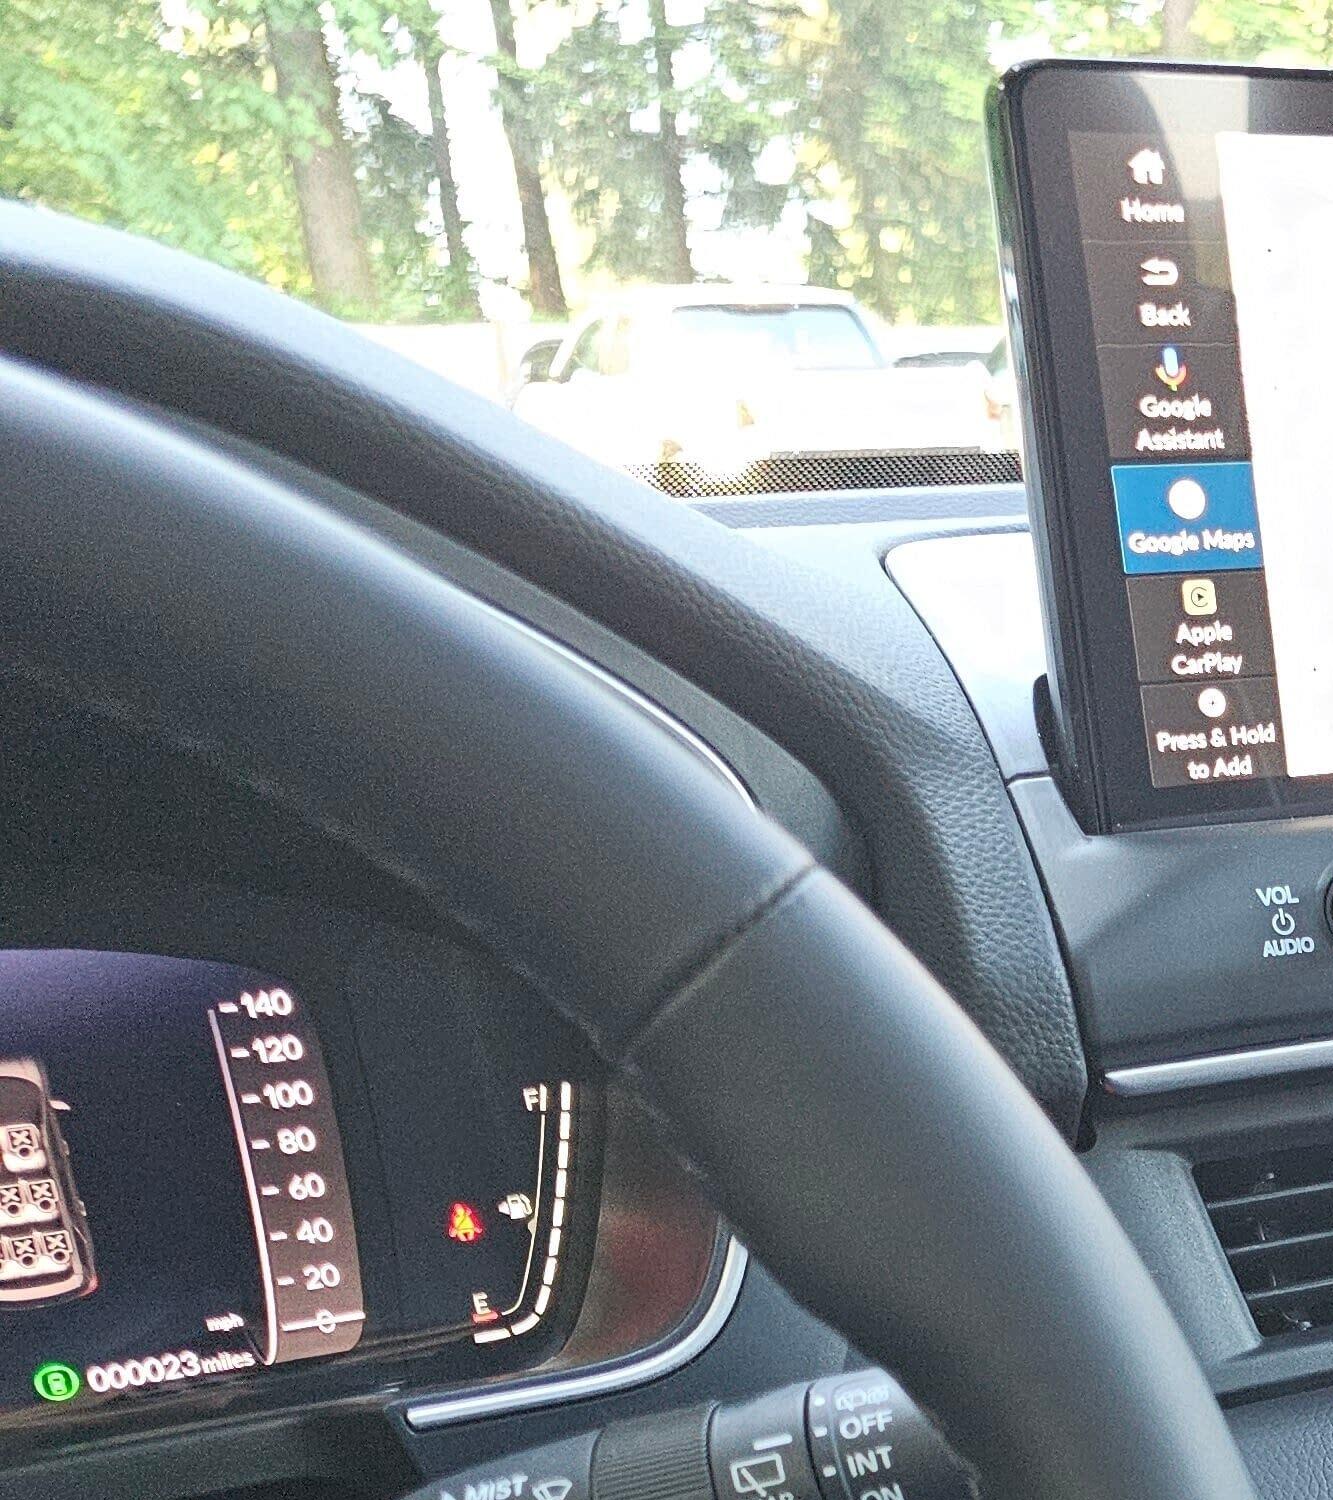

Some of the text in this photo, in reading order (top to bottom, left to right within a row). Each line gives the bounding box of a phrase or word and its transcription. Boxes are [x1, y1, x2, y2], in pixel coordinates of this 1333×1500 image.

[1120, 197, 1185, 222] Home
[1138, 302, 1191, 327] Back
[1139, 393, 1212, 420] Google
[1136, 427, 1225, 451] Assistant
[1128, 528, 1255, 555] Google Maps
[1176, 620, 1233, 646] Apple
[1171, 652, 1243, 676] CarPlay
[1156, 722, 1276, 753] Press & Hold
[1188, 755, 1252, 780] to Add
[1255, 885, 1299, 907] VOL
[1262, 936, 1315, 958] AUDIO
[239, 989, 293, 1019] 140
[251, 1033, 304, 1064] 120
[263, 1079, 314, 1110] 100
[522, 1087, 539, 1111] F
[277, 1125, 317, 1155] 80
[288, 1171, 326, 1200] 60
[296, 1216, 334, 1245] 40
[303, 1262, 341, 1291] 20
[472, 1291, 492, 1315] E
[206, 1312, 245, 1333] mph
[86, 1350, 255, 1394] 000023 miles
[839, 1408, 892, 1439] OFF
[846, 1445, 892, 1478] INT
